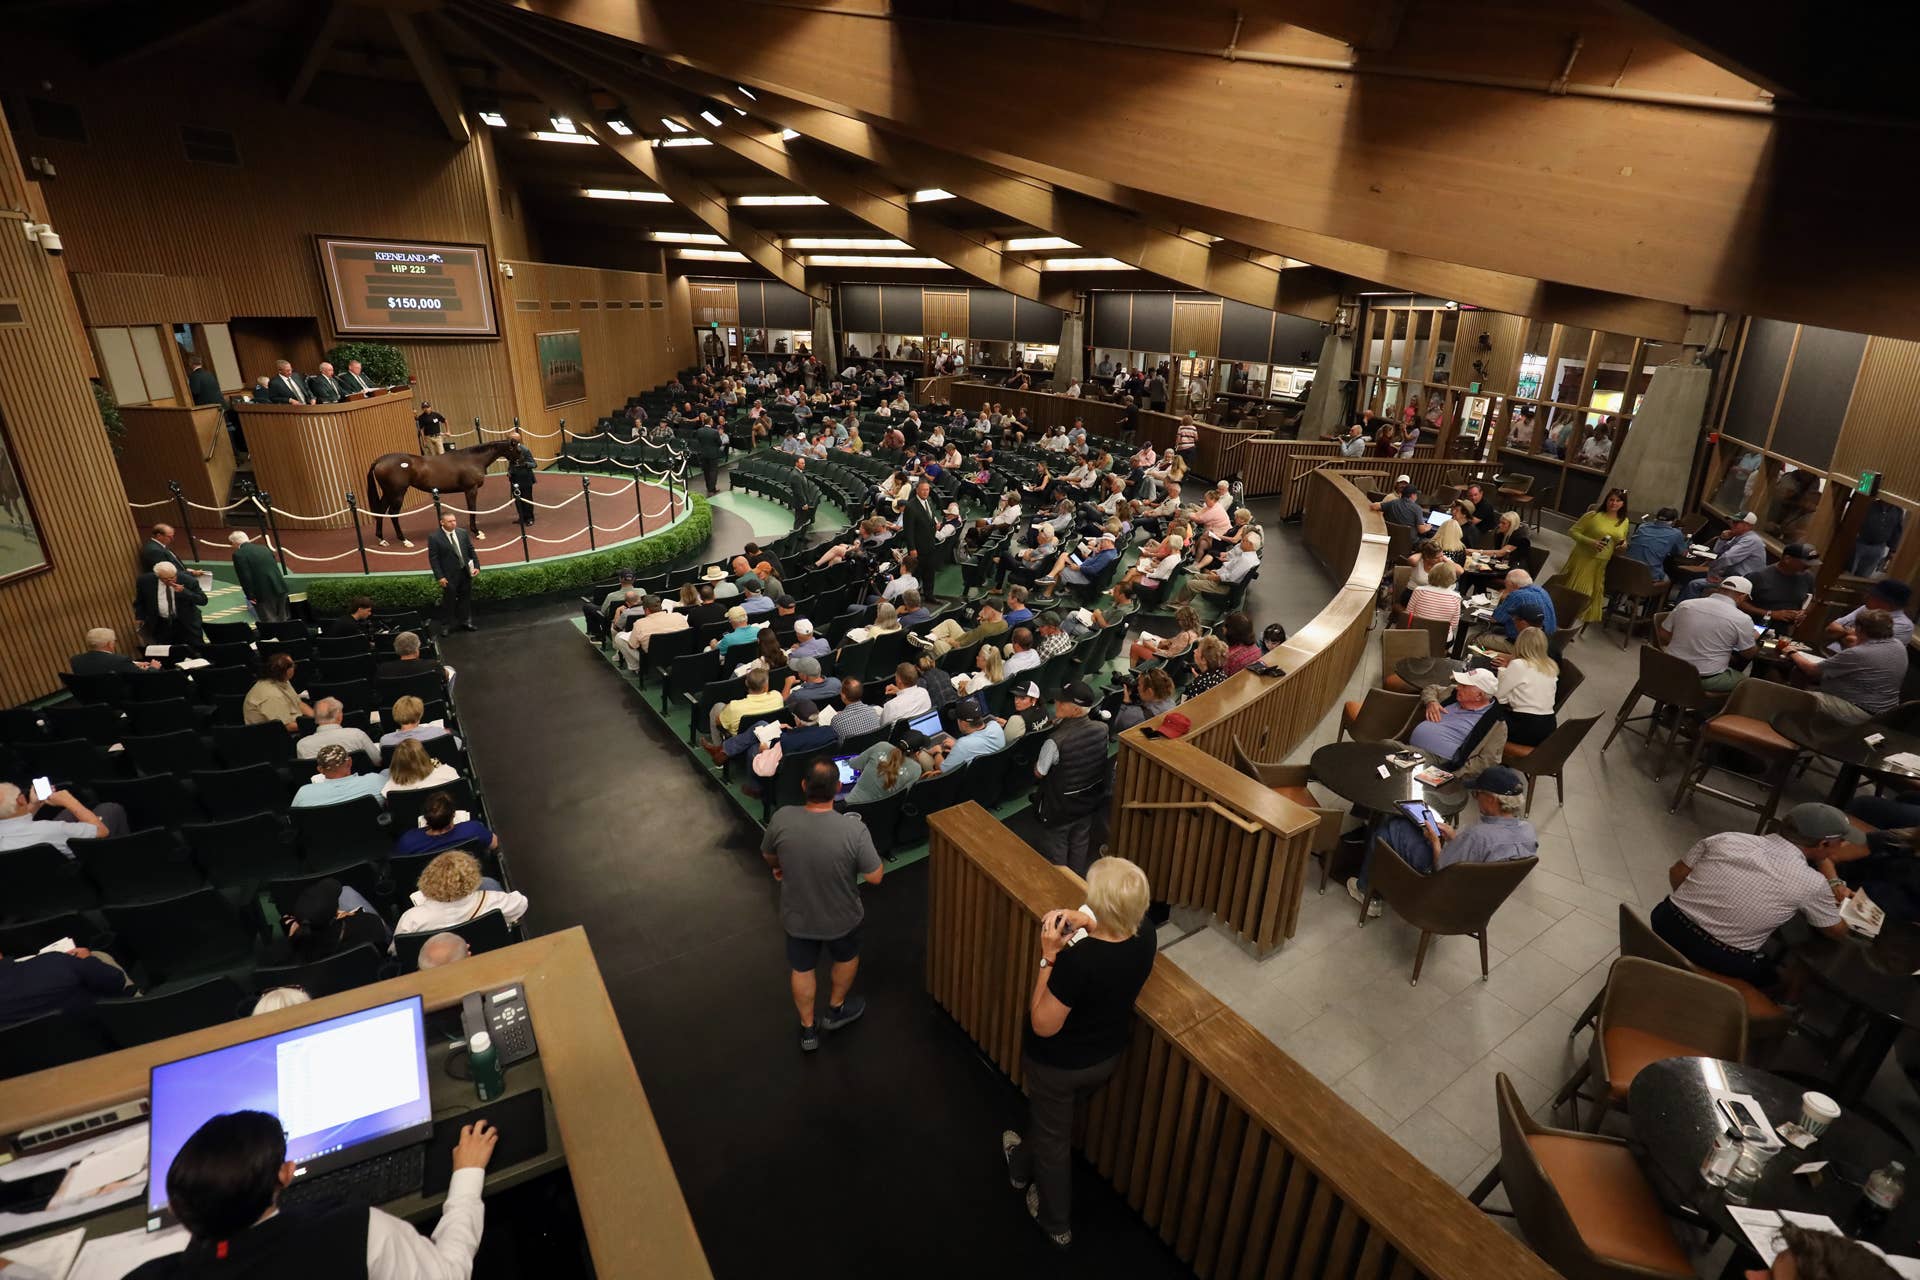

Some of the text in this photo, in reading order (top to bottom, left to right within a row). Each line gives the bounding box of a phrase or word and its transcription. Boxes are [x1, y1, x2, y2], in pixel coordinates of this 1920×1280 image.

[375, 252, 425, 262] KEENELAND
[391, 264, 426, 273] HIP 225
[388, 297, 441, 309] $150,000
